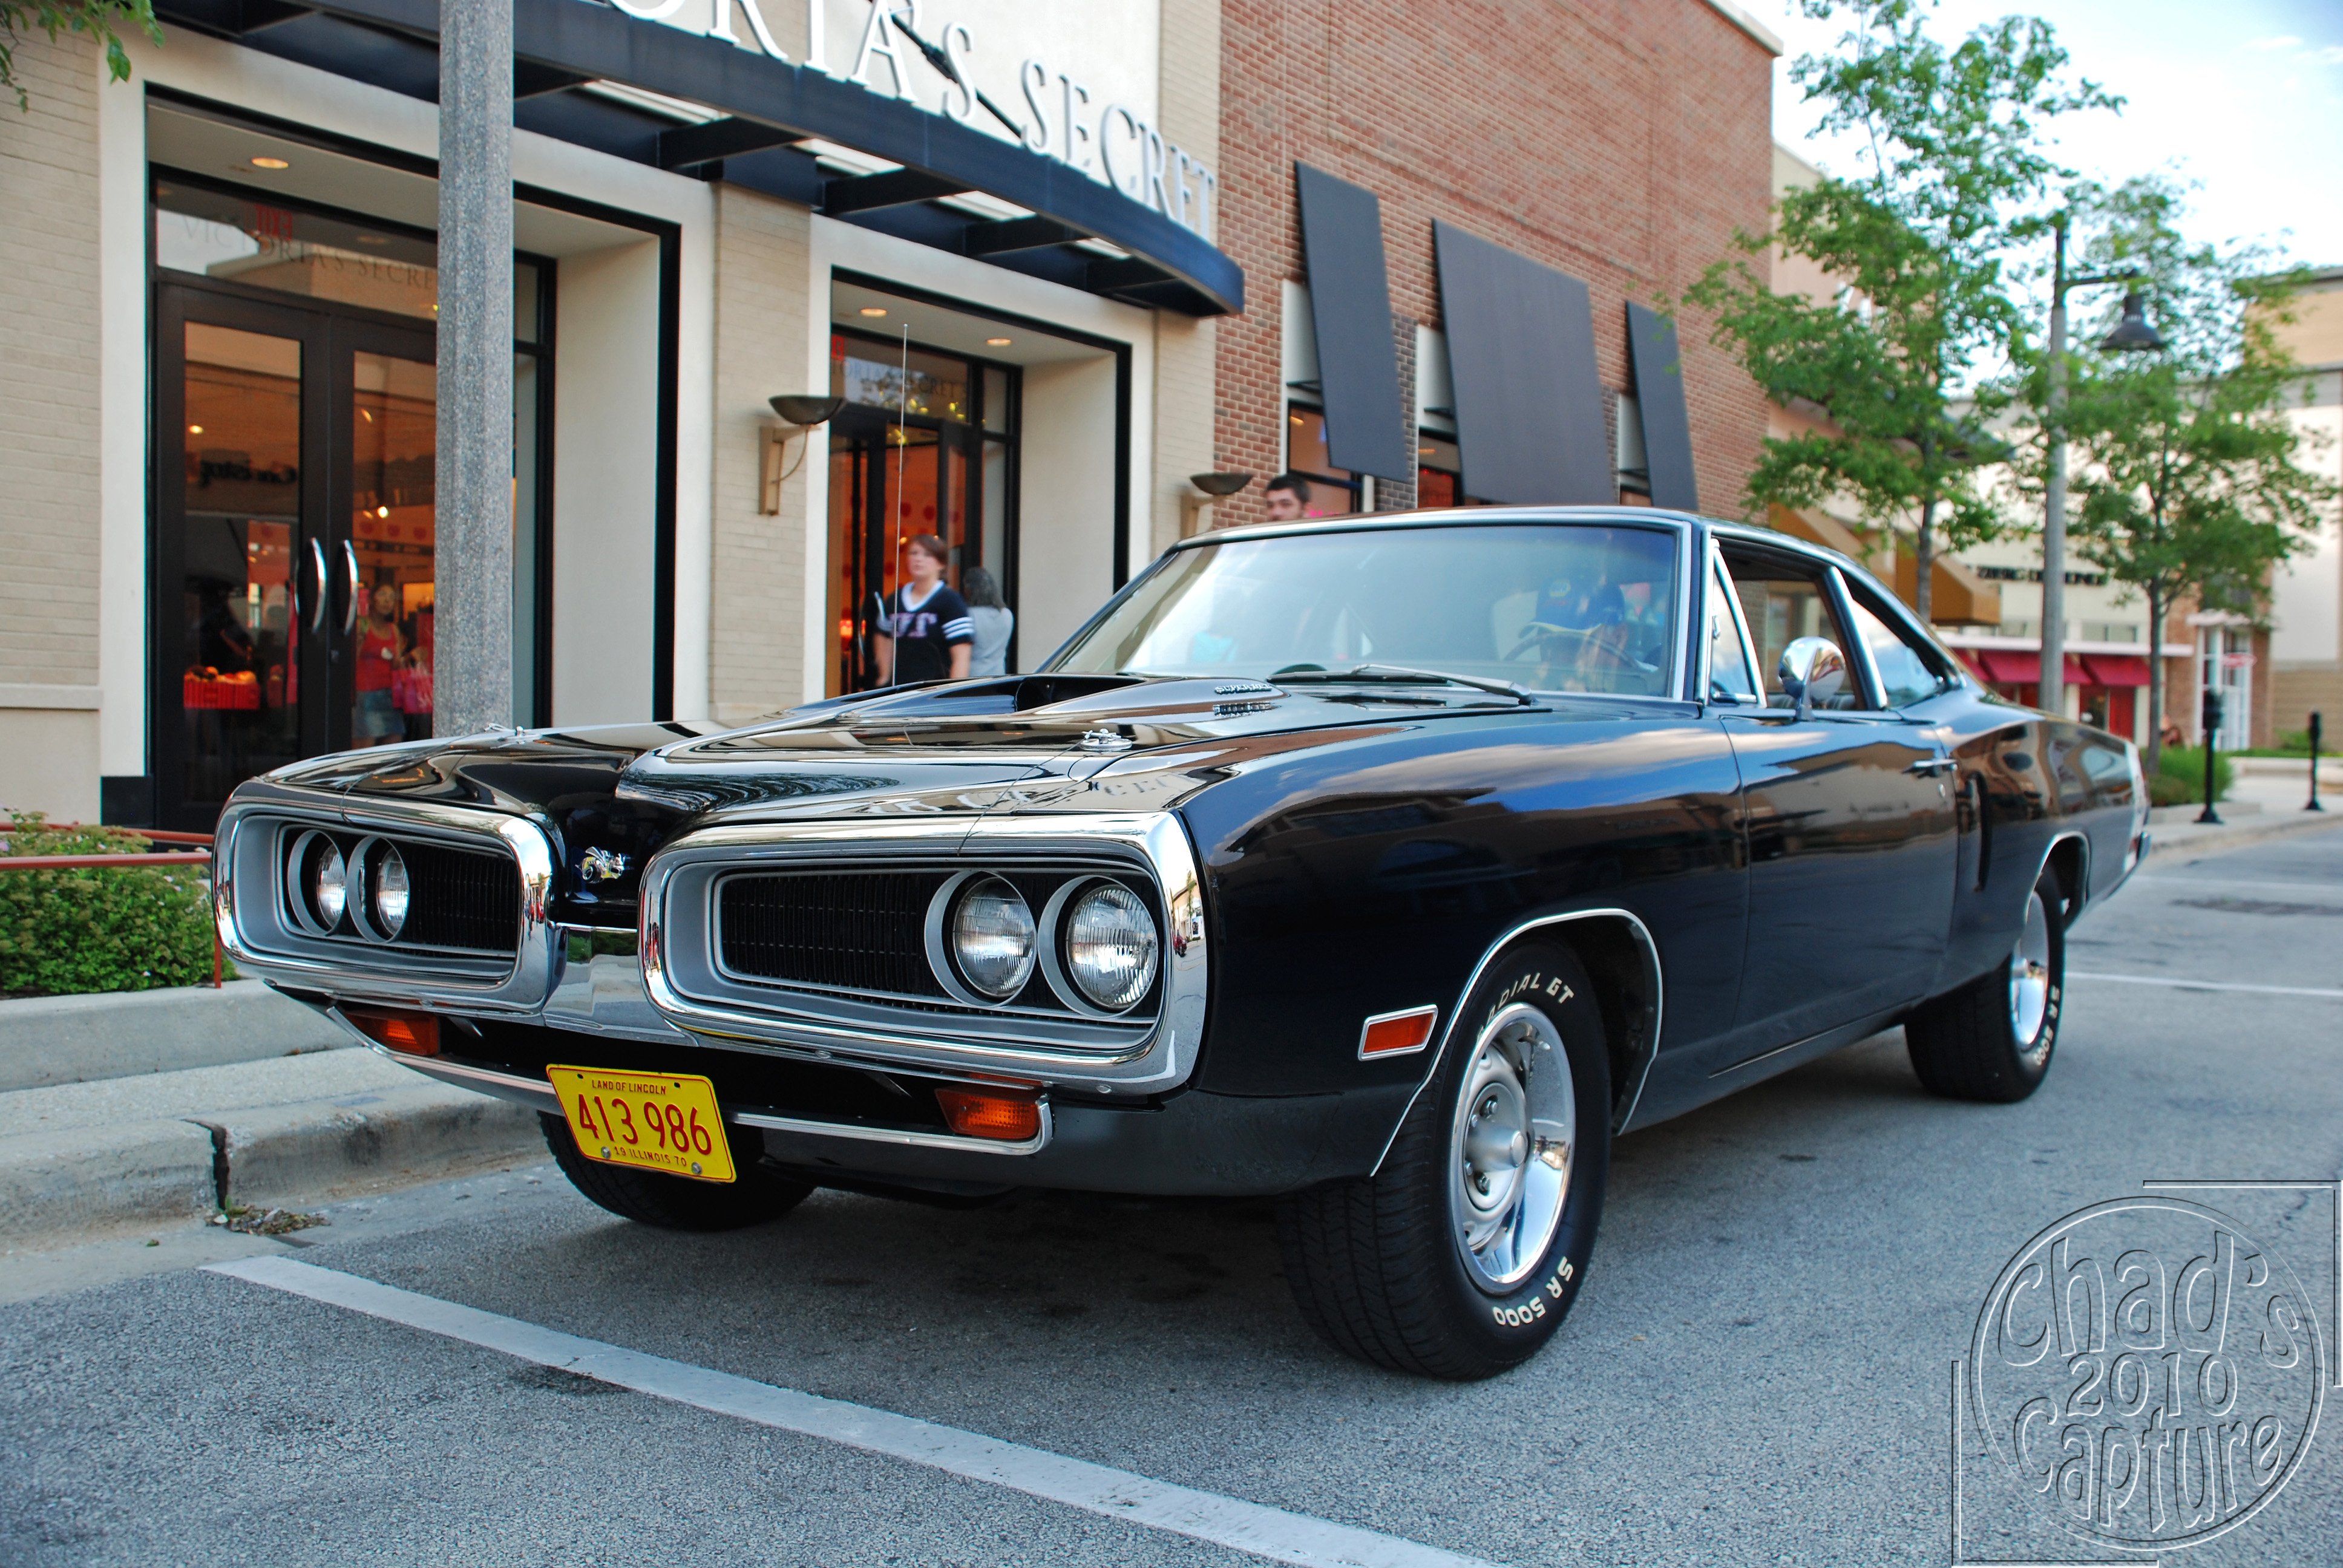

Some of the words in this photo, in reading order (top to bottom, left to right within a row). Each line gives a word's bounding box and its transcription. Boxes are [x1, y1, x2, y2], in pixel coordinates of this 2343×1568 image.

[1020, 57, 1216, 243] SECRET
[183, 215, 344, 270] VICTORIAS
[358, 256, 434, 290] SECRE
[1546, 977, 1575, 1004] GT
[591, 1079, 614, 1090] LAND
[615, 1081, 627, 1091] OF
[629, 1083, 667, 1095] LINCOLN
[578, 1094, 638, 1145] 413
[644, 1102, 712, 1155] 986
[614, 1146, 627, 1156] 19
[629, 1148, 671, 1164] ILLINOIS
[673, 1155, 687, 1167] 70
[1493, 1296, 1546, 1327] 5000
